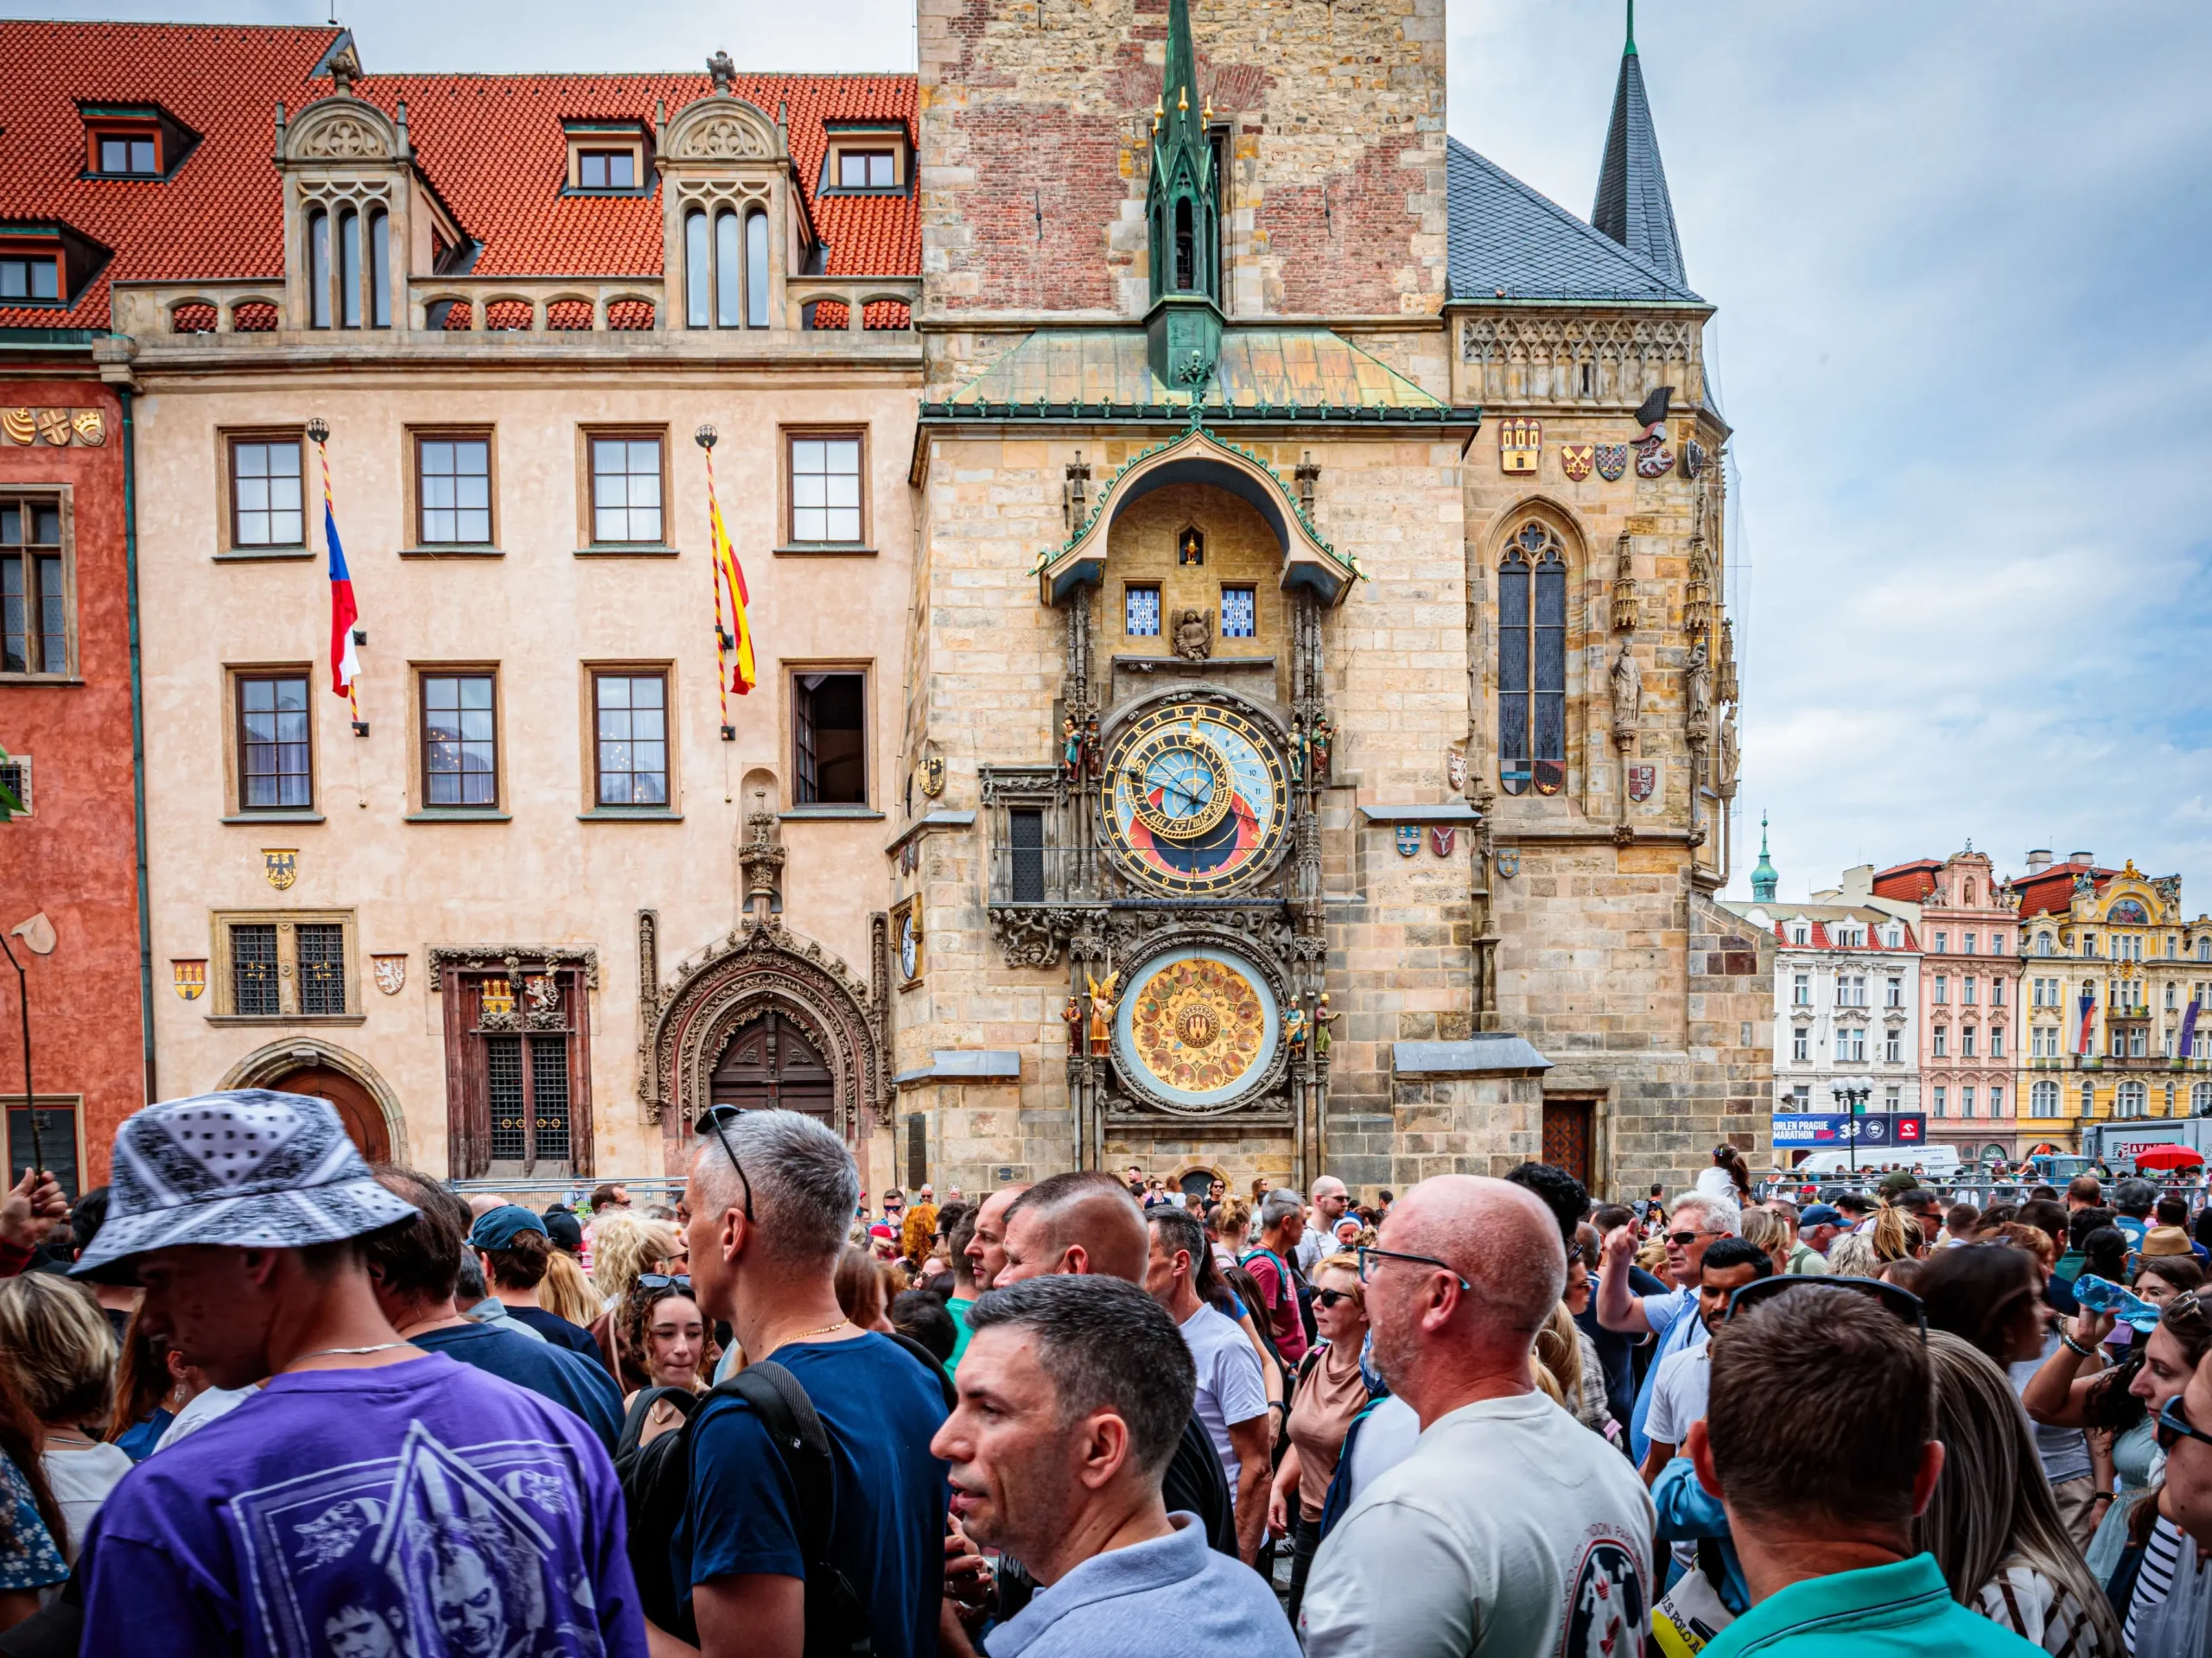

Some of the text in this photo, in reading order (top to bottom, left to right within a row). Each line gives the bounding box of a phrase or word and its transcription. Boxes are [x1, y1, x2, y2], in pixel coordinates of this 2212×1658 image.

[1773, 1121, 1828, 1130] ORLEN PRAGUE
[1773, 1130, 1814, 1140] MARATHON
[1661, 1593, 1675, 1616] U.S.
[1669, 1610, 1692, 1642] POLO
